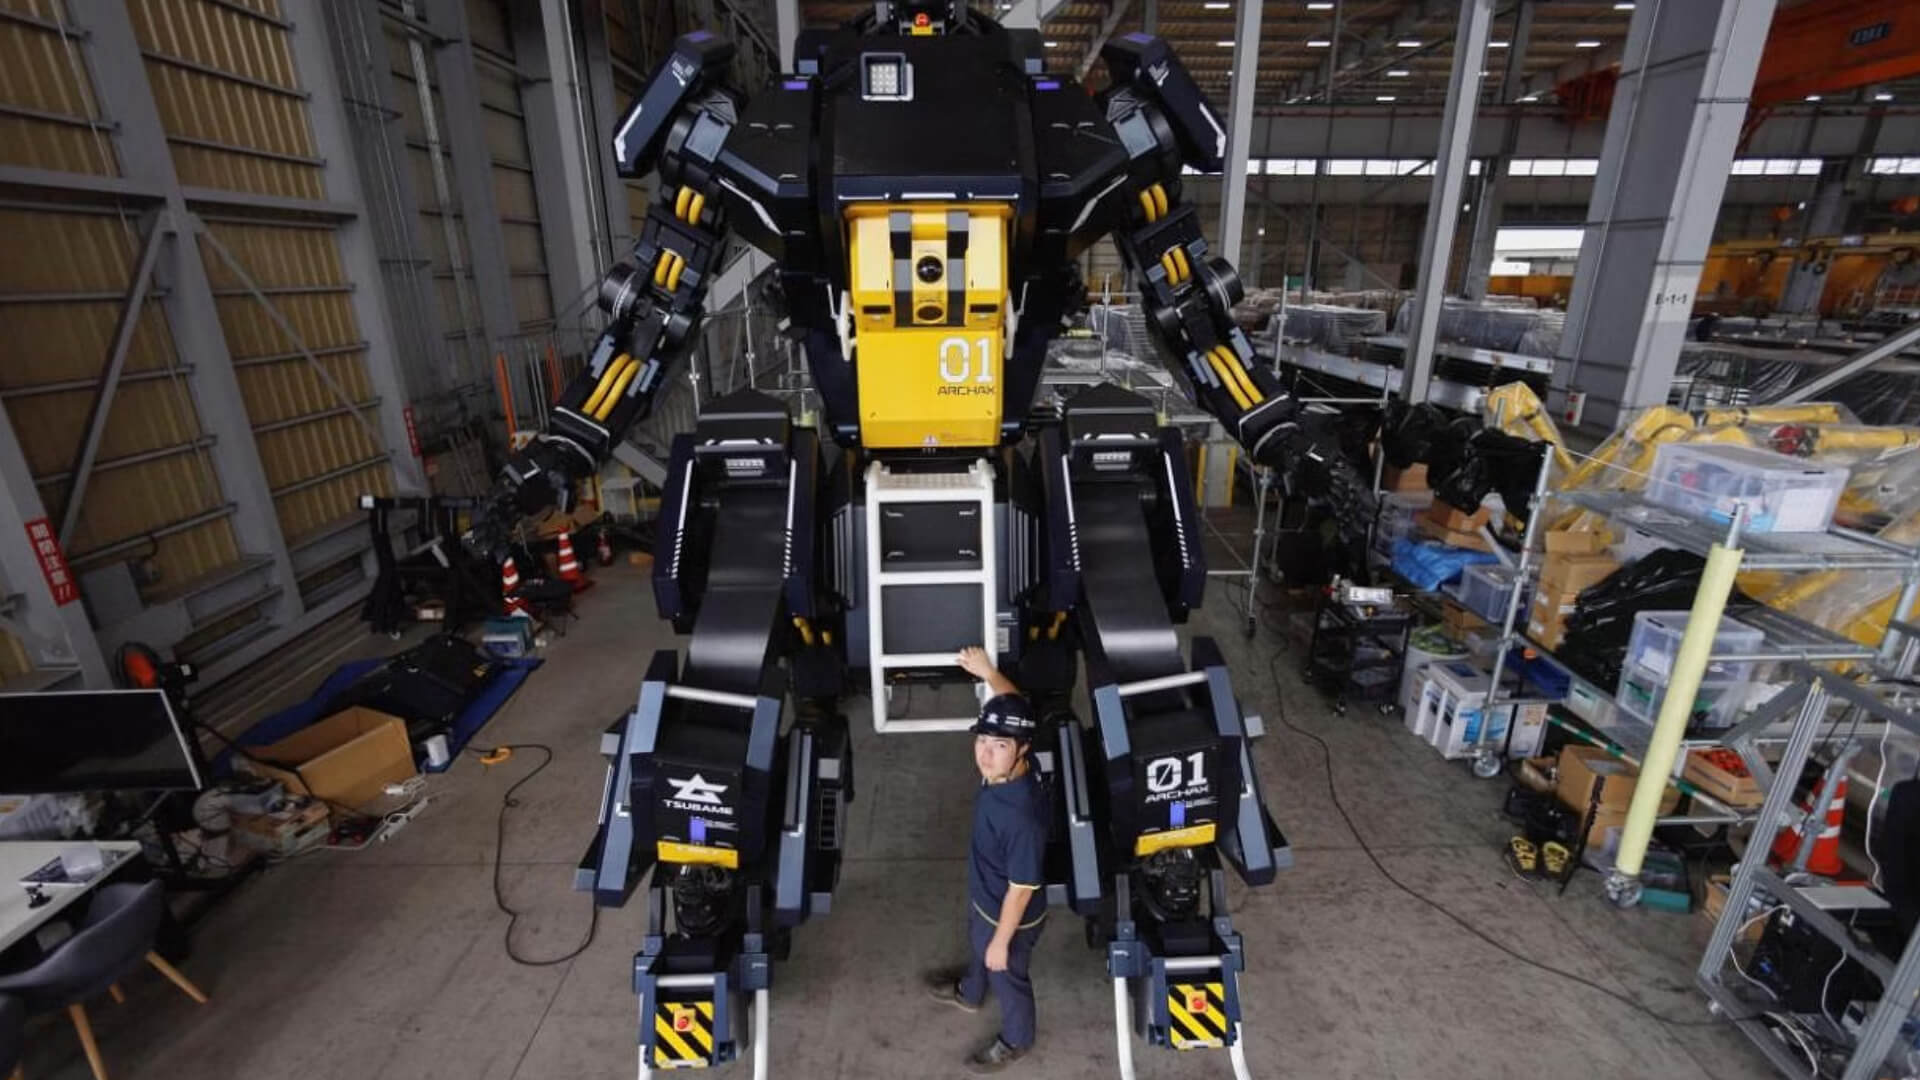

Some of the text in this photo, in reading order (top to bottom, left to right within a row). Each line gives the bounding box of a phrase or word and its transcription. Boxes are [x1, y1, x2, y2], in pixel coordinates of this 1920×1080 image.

[940, 337, 993, 383] 01
[937, 385, 996, 396] ARCHAX
[1147, 751, 1208, 793] 01
[1145, 784, 1209, 803] ARCHAX
[663, 799, 734, 815] TSUBAME
